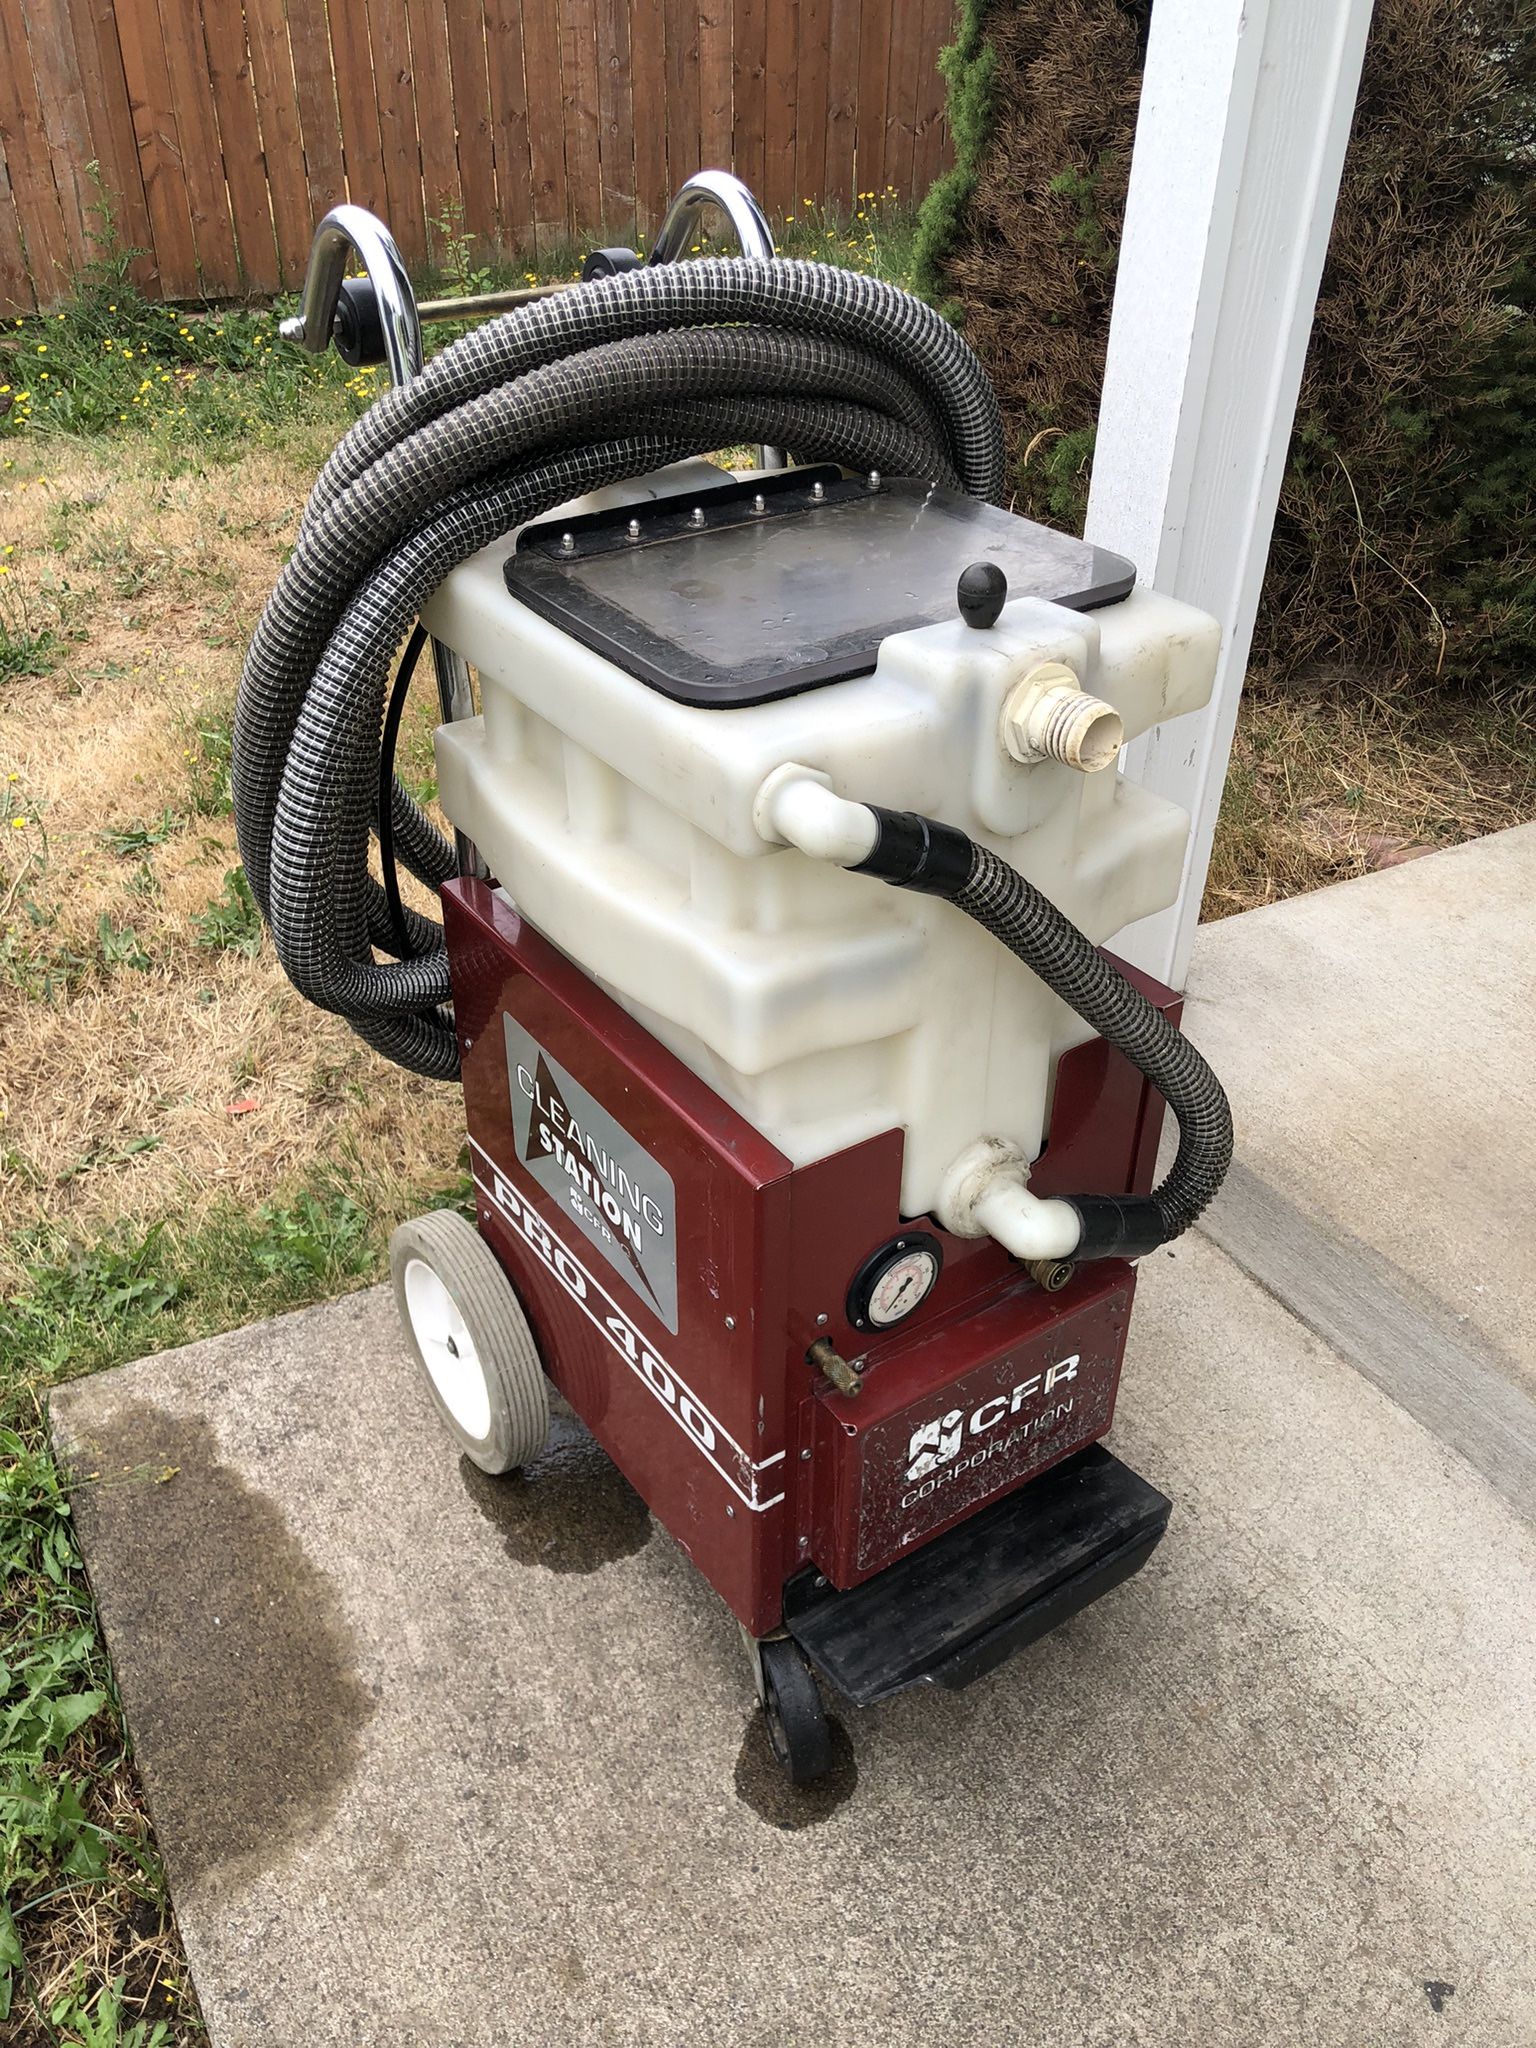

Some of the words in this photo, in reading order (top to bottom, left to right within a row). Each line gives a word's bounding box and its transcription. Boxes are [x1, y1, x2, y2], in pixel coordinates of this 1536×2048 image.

[517, 1063, 664, 1236] CLEANING
[539, 1122, 642, 1253] STATION
[583, 1206, 612, 1244] CFR
[494, 1174, 587, 1298] PRO
[606, 1316, 716, 1451] 400
[901, 1398, 1075, 1509] CORPORATION
[969, 1353, 1081, 1436] CFR
